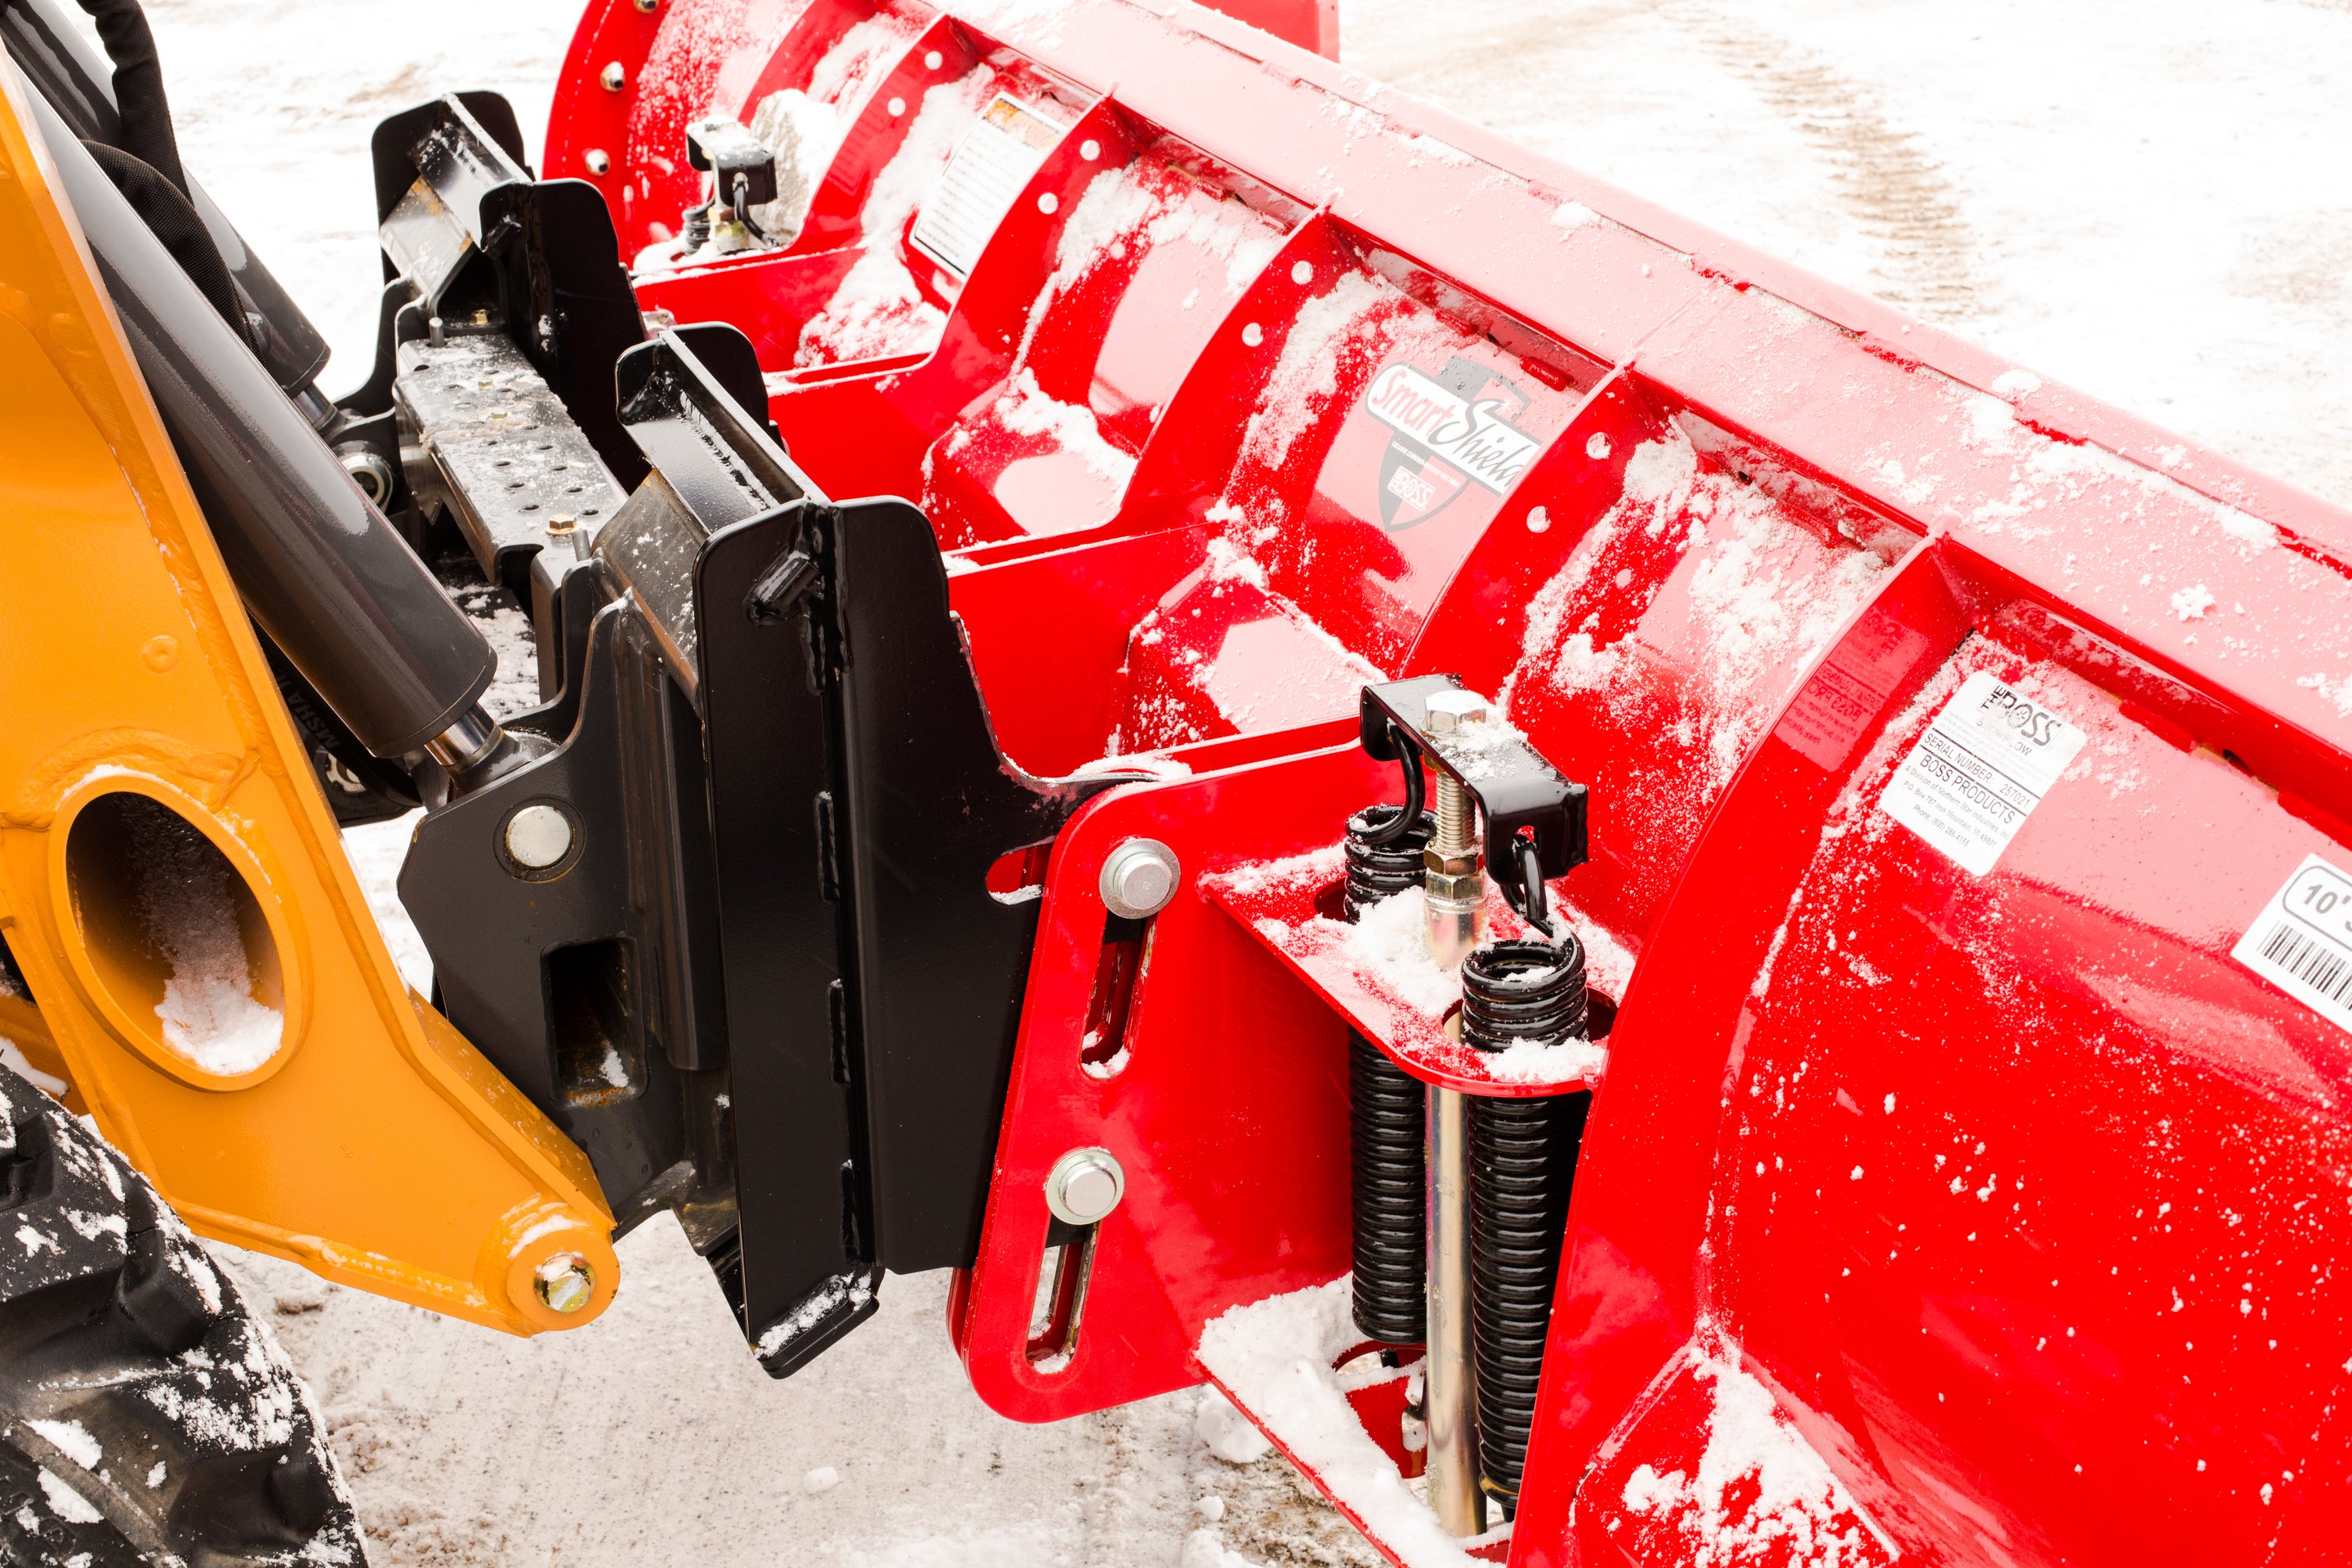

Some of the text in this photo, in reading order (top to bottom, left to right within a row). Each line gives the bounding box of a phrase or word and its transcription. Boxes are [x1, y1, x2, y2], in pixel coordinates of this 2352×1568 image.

[1396, 472, 1432, 506] BOSS
[287, 690, 341, 749] MSHA
[1980, 684, 2007, 710] THE
[1998, 690, 2063, 747] BOSS
[1910, 768, 1931, 786] Division
[1937, 786, 1960, 806] Northern
[1914, 788, 1925, 799] Box
[1926, 795, 1936, 804] 787
[1919, 752, 2015, 823] BOSS PRODUCTS
[1924, 733, 1954, 759] SERIAL
[1954, 753, 1993, 784] NUMBER:
[1999, 784, 2030, 808] 257021
